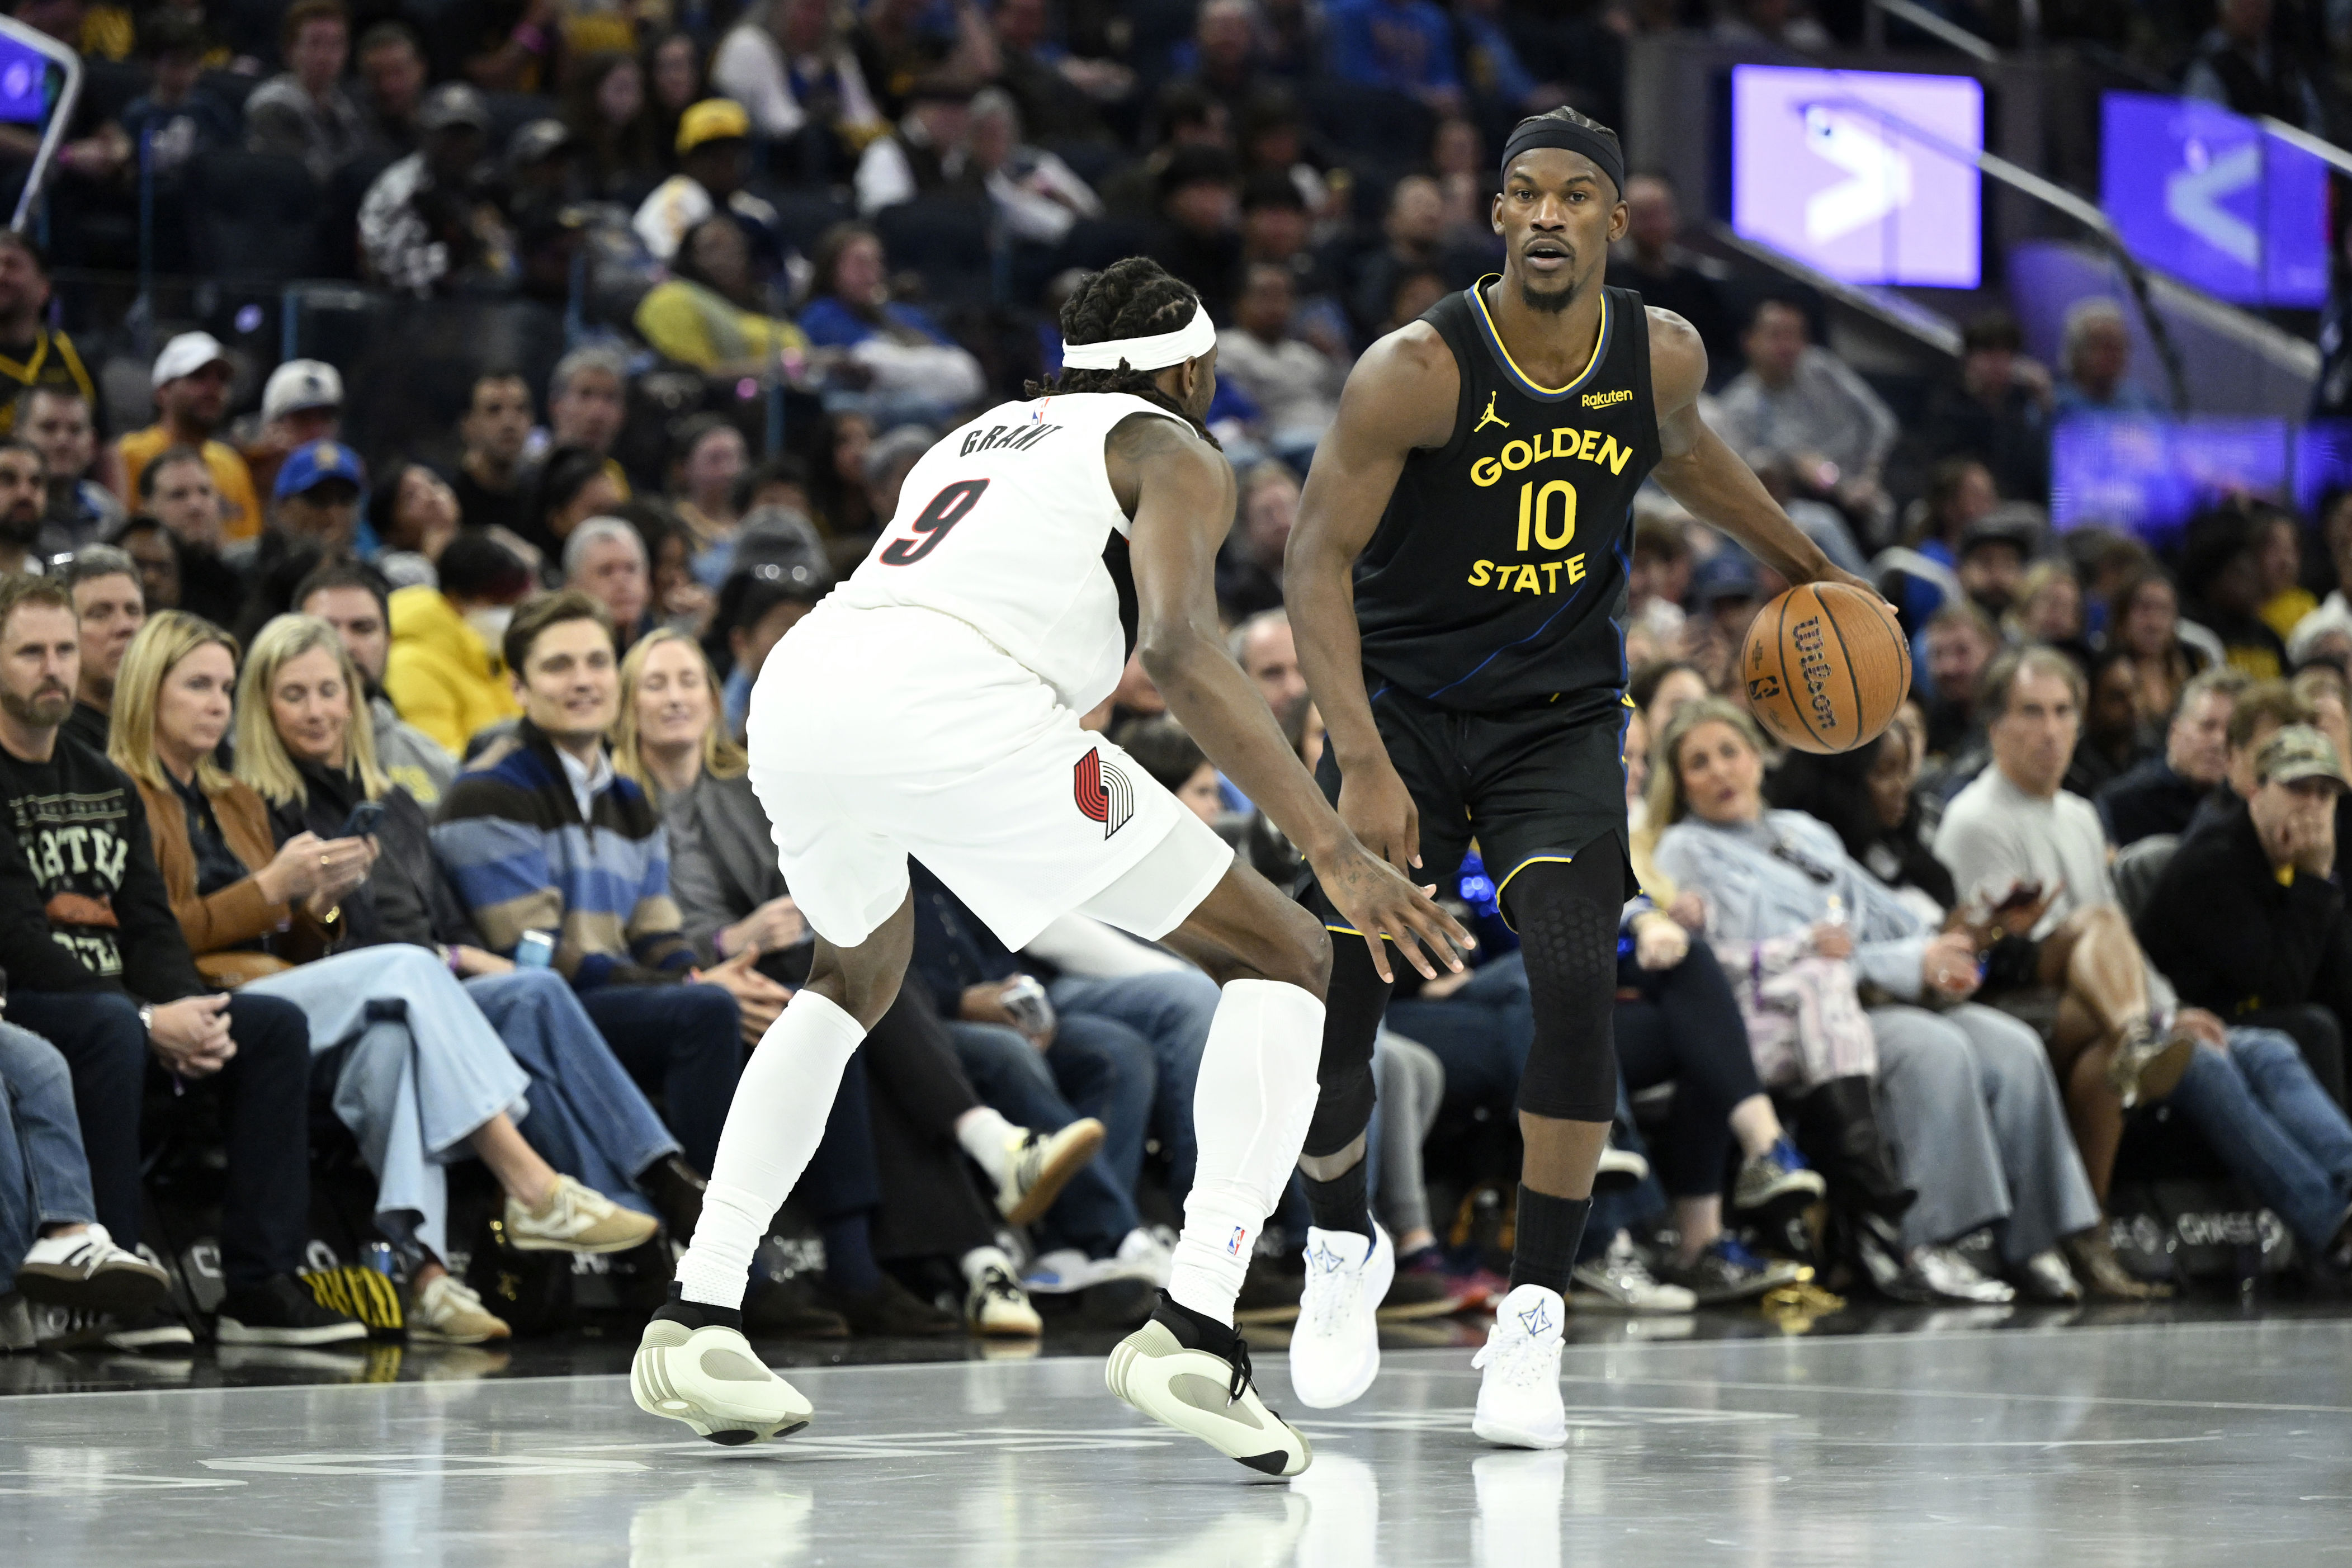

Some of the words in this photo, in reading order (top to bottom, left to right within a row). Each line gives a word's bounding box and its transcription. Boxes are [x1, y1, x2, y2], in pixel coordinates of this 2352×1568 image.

[1581, 389, 1633, 408] Rakuten
[960, 424, 1064, 457] GRANT
[1470, 427, 1633, 487] GOLDEN
[879, 478, 990, 566] 9
[1516, 479, 1577, 551] 10
[1467, 552, 1586, 596] STATE
[1792, 615, 1838, 730] Wilson
